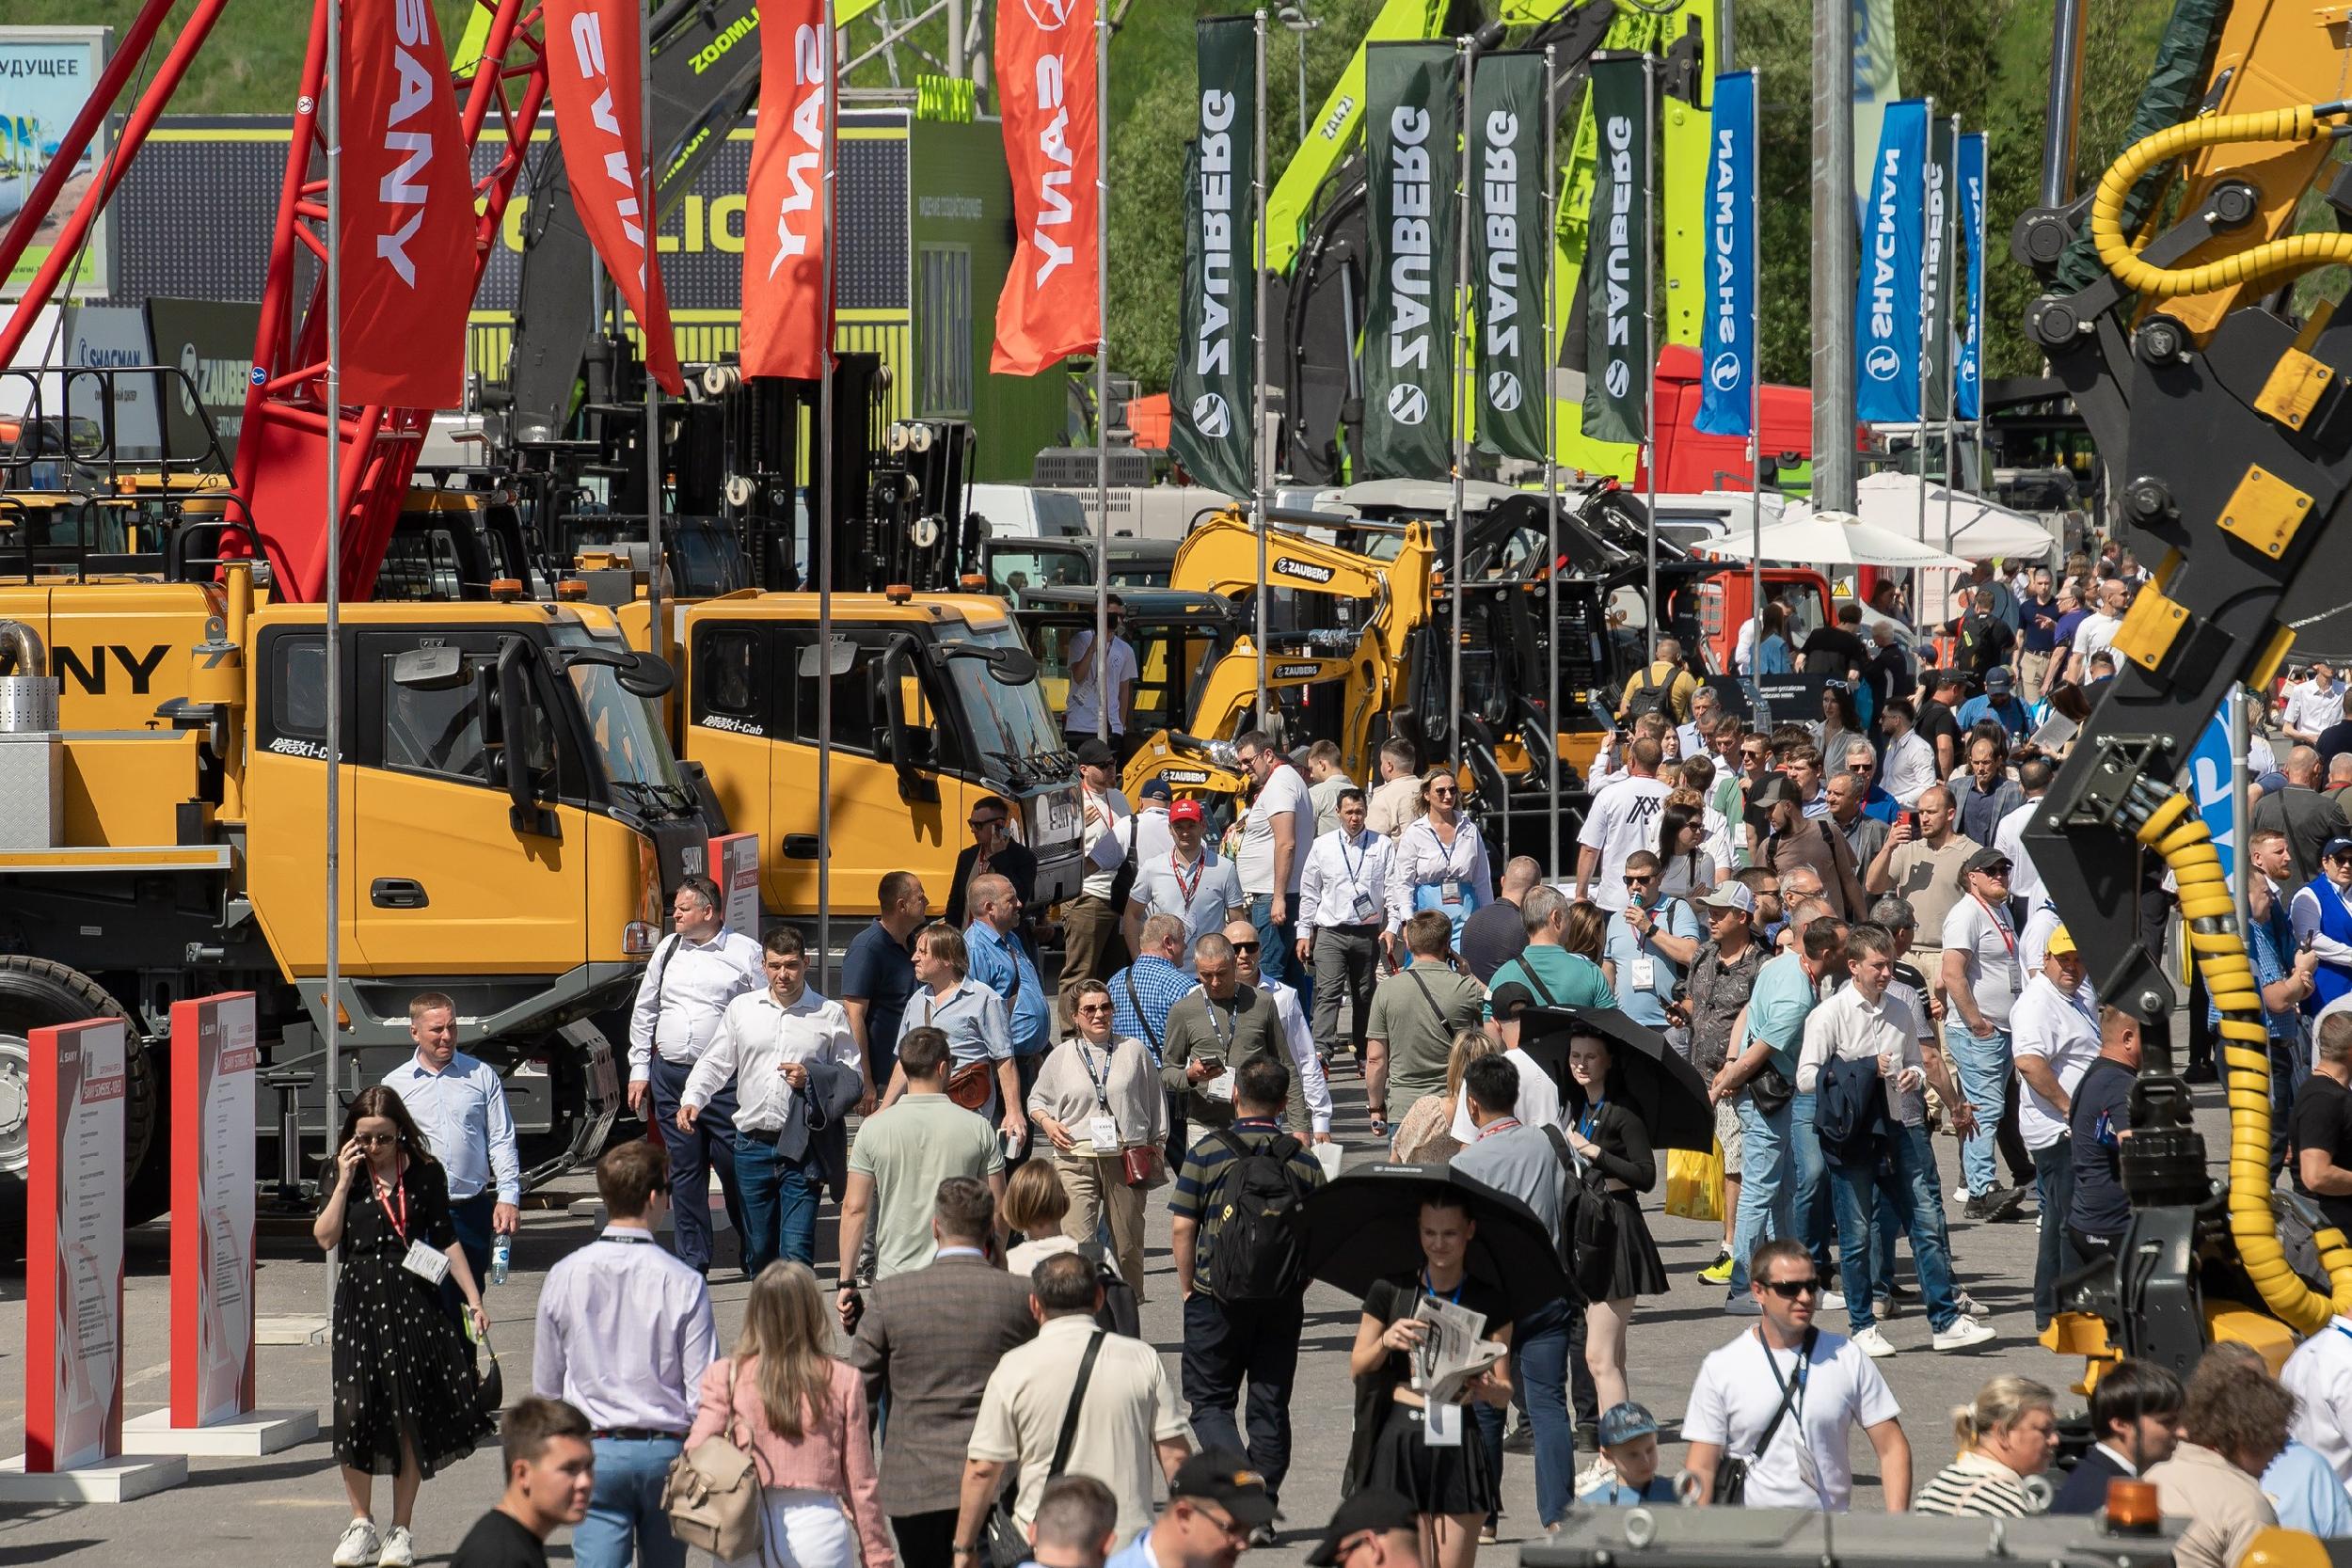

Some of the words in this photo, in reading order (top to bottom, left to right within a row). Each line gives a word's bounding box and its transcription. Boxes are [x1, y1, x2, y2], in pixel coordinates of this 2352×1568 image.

[688, 7, 760, 75] ZOOML
[0, 58, 78, 78] УДУЩЕЕ
[376, 0, 434, 290] SANY
[199, 358, 253, 406] ZAUBE
[1288, 562, 1329, 582] ZAUBERG
[52, 644, 173, 695] NY
[1284, 665, 1317, 676] ZAUBERG
[1169, 770, 1207, 783] ZAUBERG
